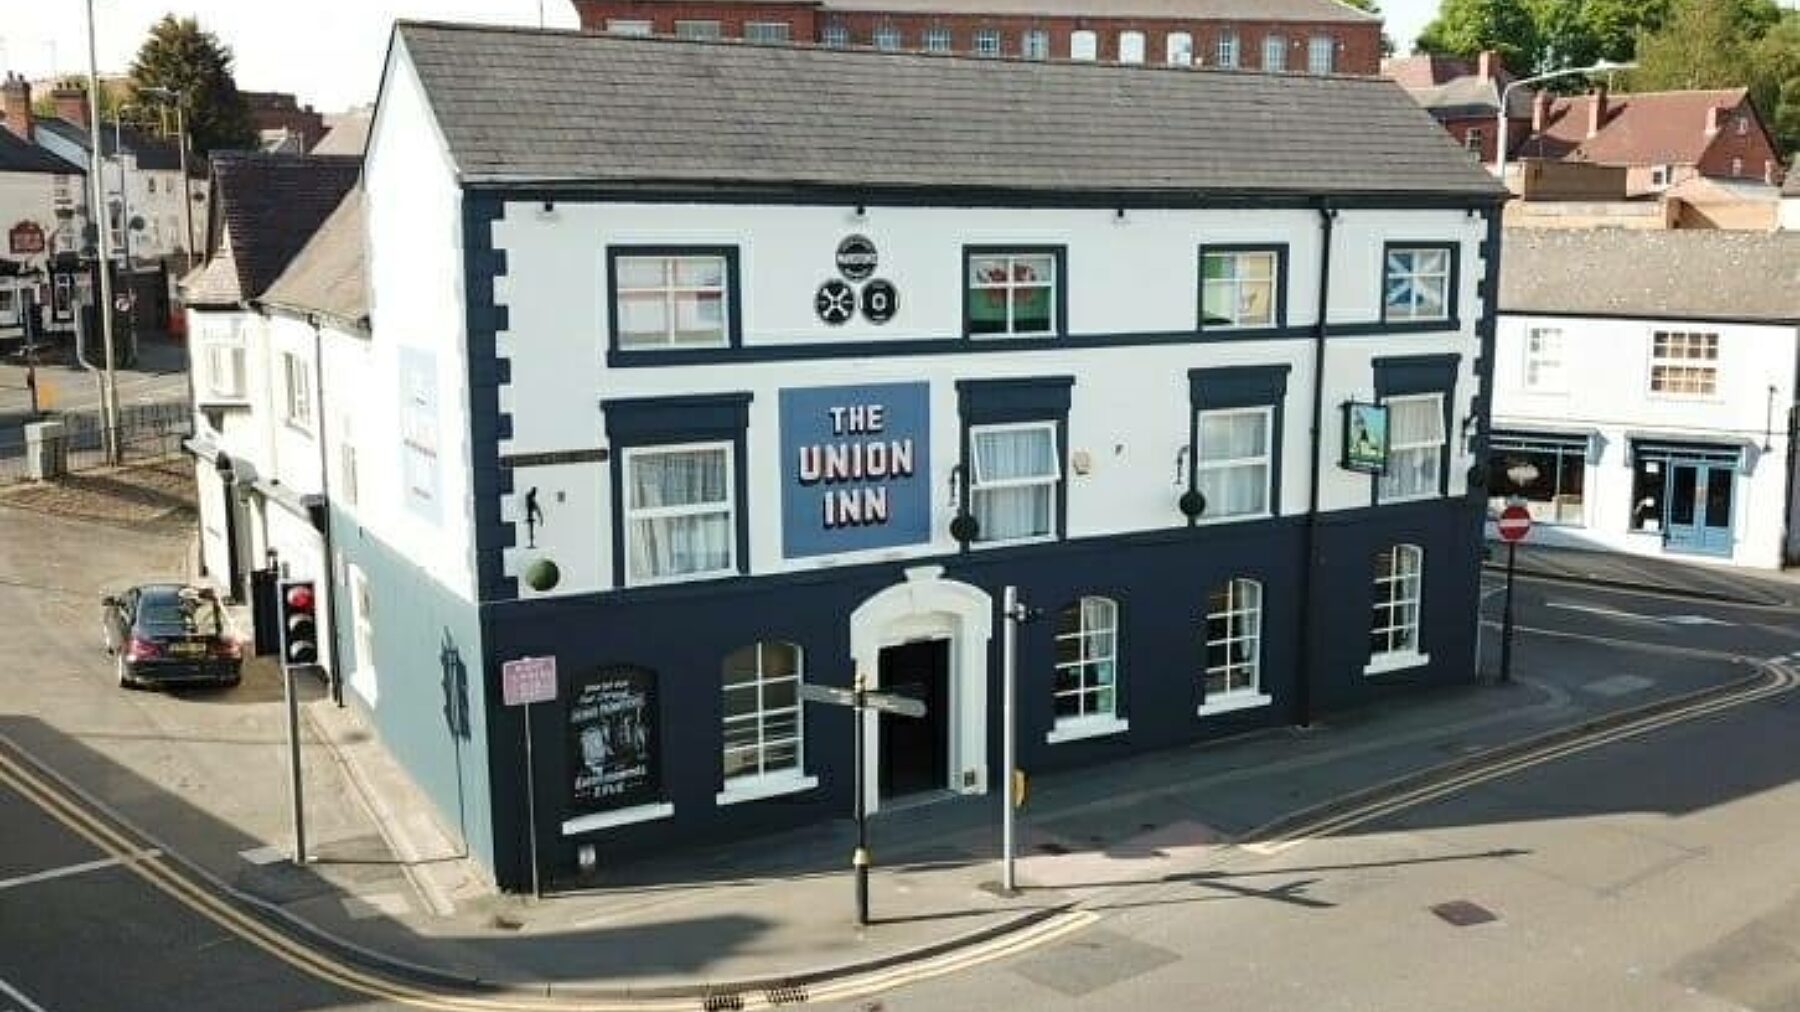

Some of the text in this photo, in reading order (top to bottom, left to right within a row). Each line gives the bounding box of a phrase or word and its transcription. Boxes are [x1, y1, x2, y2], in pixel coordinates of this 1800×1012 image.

[830, 404, 884, 434] THE
[798, 439, 914, 486] UNION
[823, 486, 888, 529] INN
